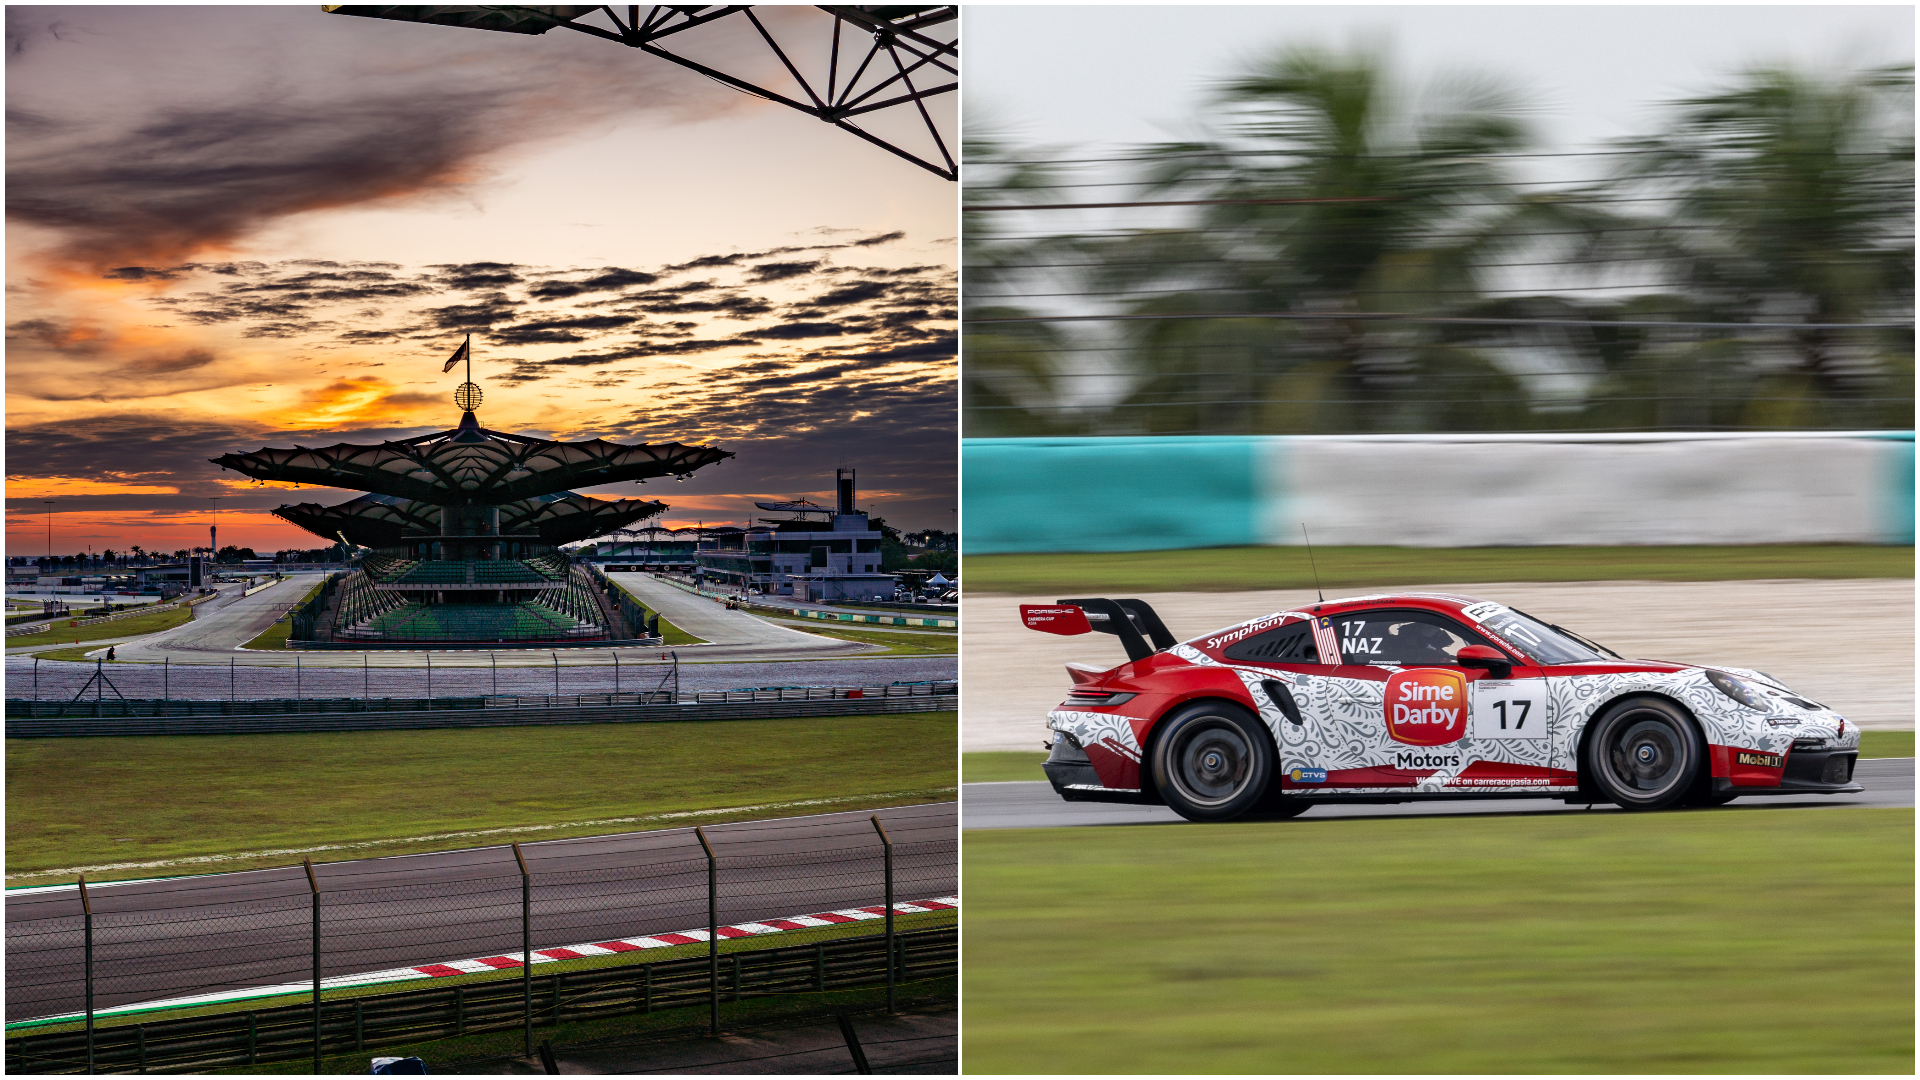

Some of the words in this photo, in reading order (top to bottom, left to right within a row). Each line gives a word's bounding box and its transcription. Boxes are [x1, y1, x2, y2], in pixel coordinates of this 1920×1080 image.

[1207, 615, 1286, 649] Symphony
[1341, 621, 1365, 636] 17
[1504, 624, 1541, 646] 17
[1341, 638, 1382, 654] NAZ
[1475, 624, 1525, 659] www.porsche.com
[1399, 682, 1454, 701] Sime
[1393, 702, 1459, 730] Darby
[1492, 700, 1532, 730] 17
[1397, 753, 1459, 767] Motors
[1740, 753, 1771, 766] Mobil
[1474, 777, 1550, 787] carreracupasia.com
